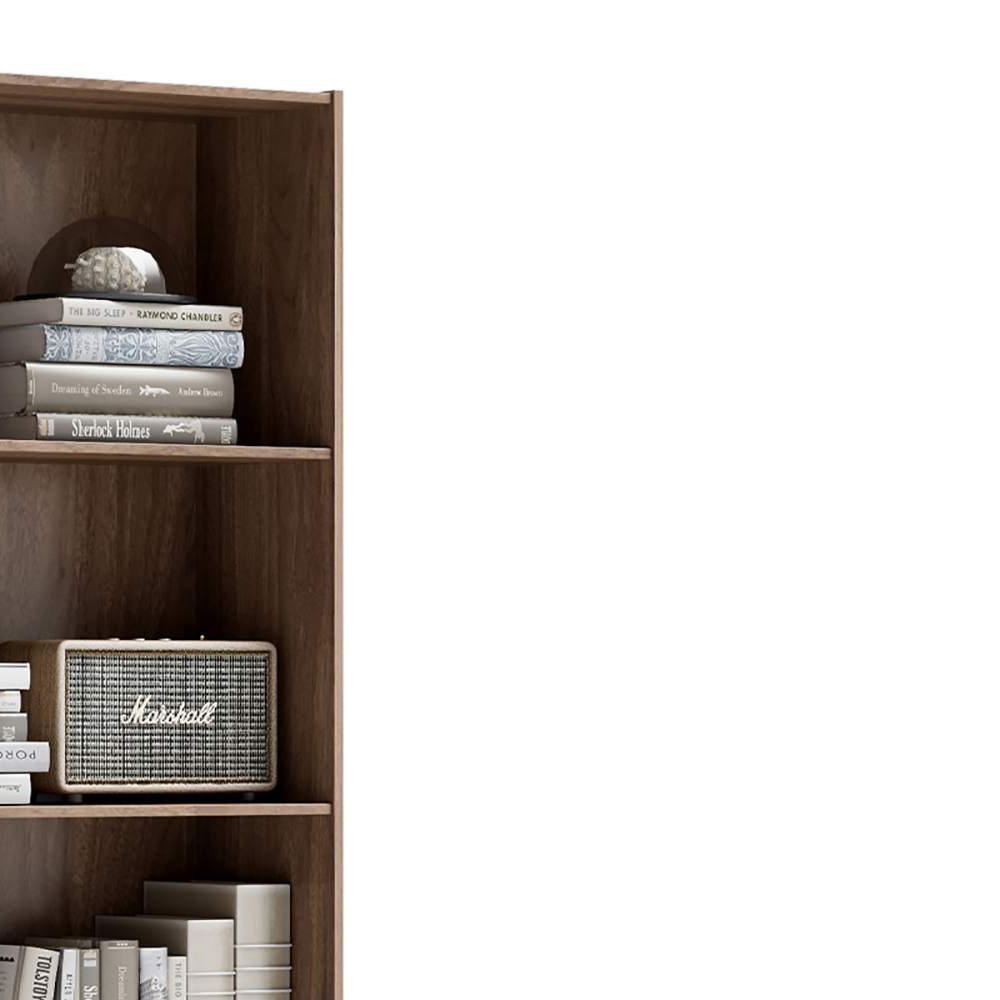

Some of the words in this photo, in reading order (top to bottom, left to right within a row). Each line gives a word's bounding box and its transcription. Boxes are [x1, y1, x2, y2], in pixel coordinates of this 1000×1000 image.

[86, 307, 101, 317] BIG
[104, 308, 126, 318] SLEEP
[136, 310, 178, 321] RAYMOND
[180, 311, 223, 323] CHANDLER
[51, 382, 90, 397] Dreaming
[91, 384, 101, 396] of
[102, 385, 132, 396] Sweden
[201, 387, 223, 397] Brown
[71, 419, 112, 438] Sherlock
[115, 420, 151, 439] Holmes
[120, 695, 217, 724] Marshall
[174, 962, 182, 980] THE
[174, 982, 182, 998] BIG
